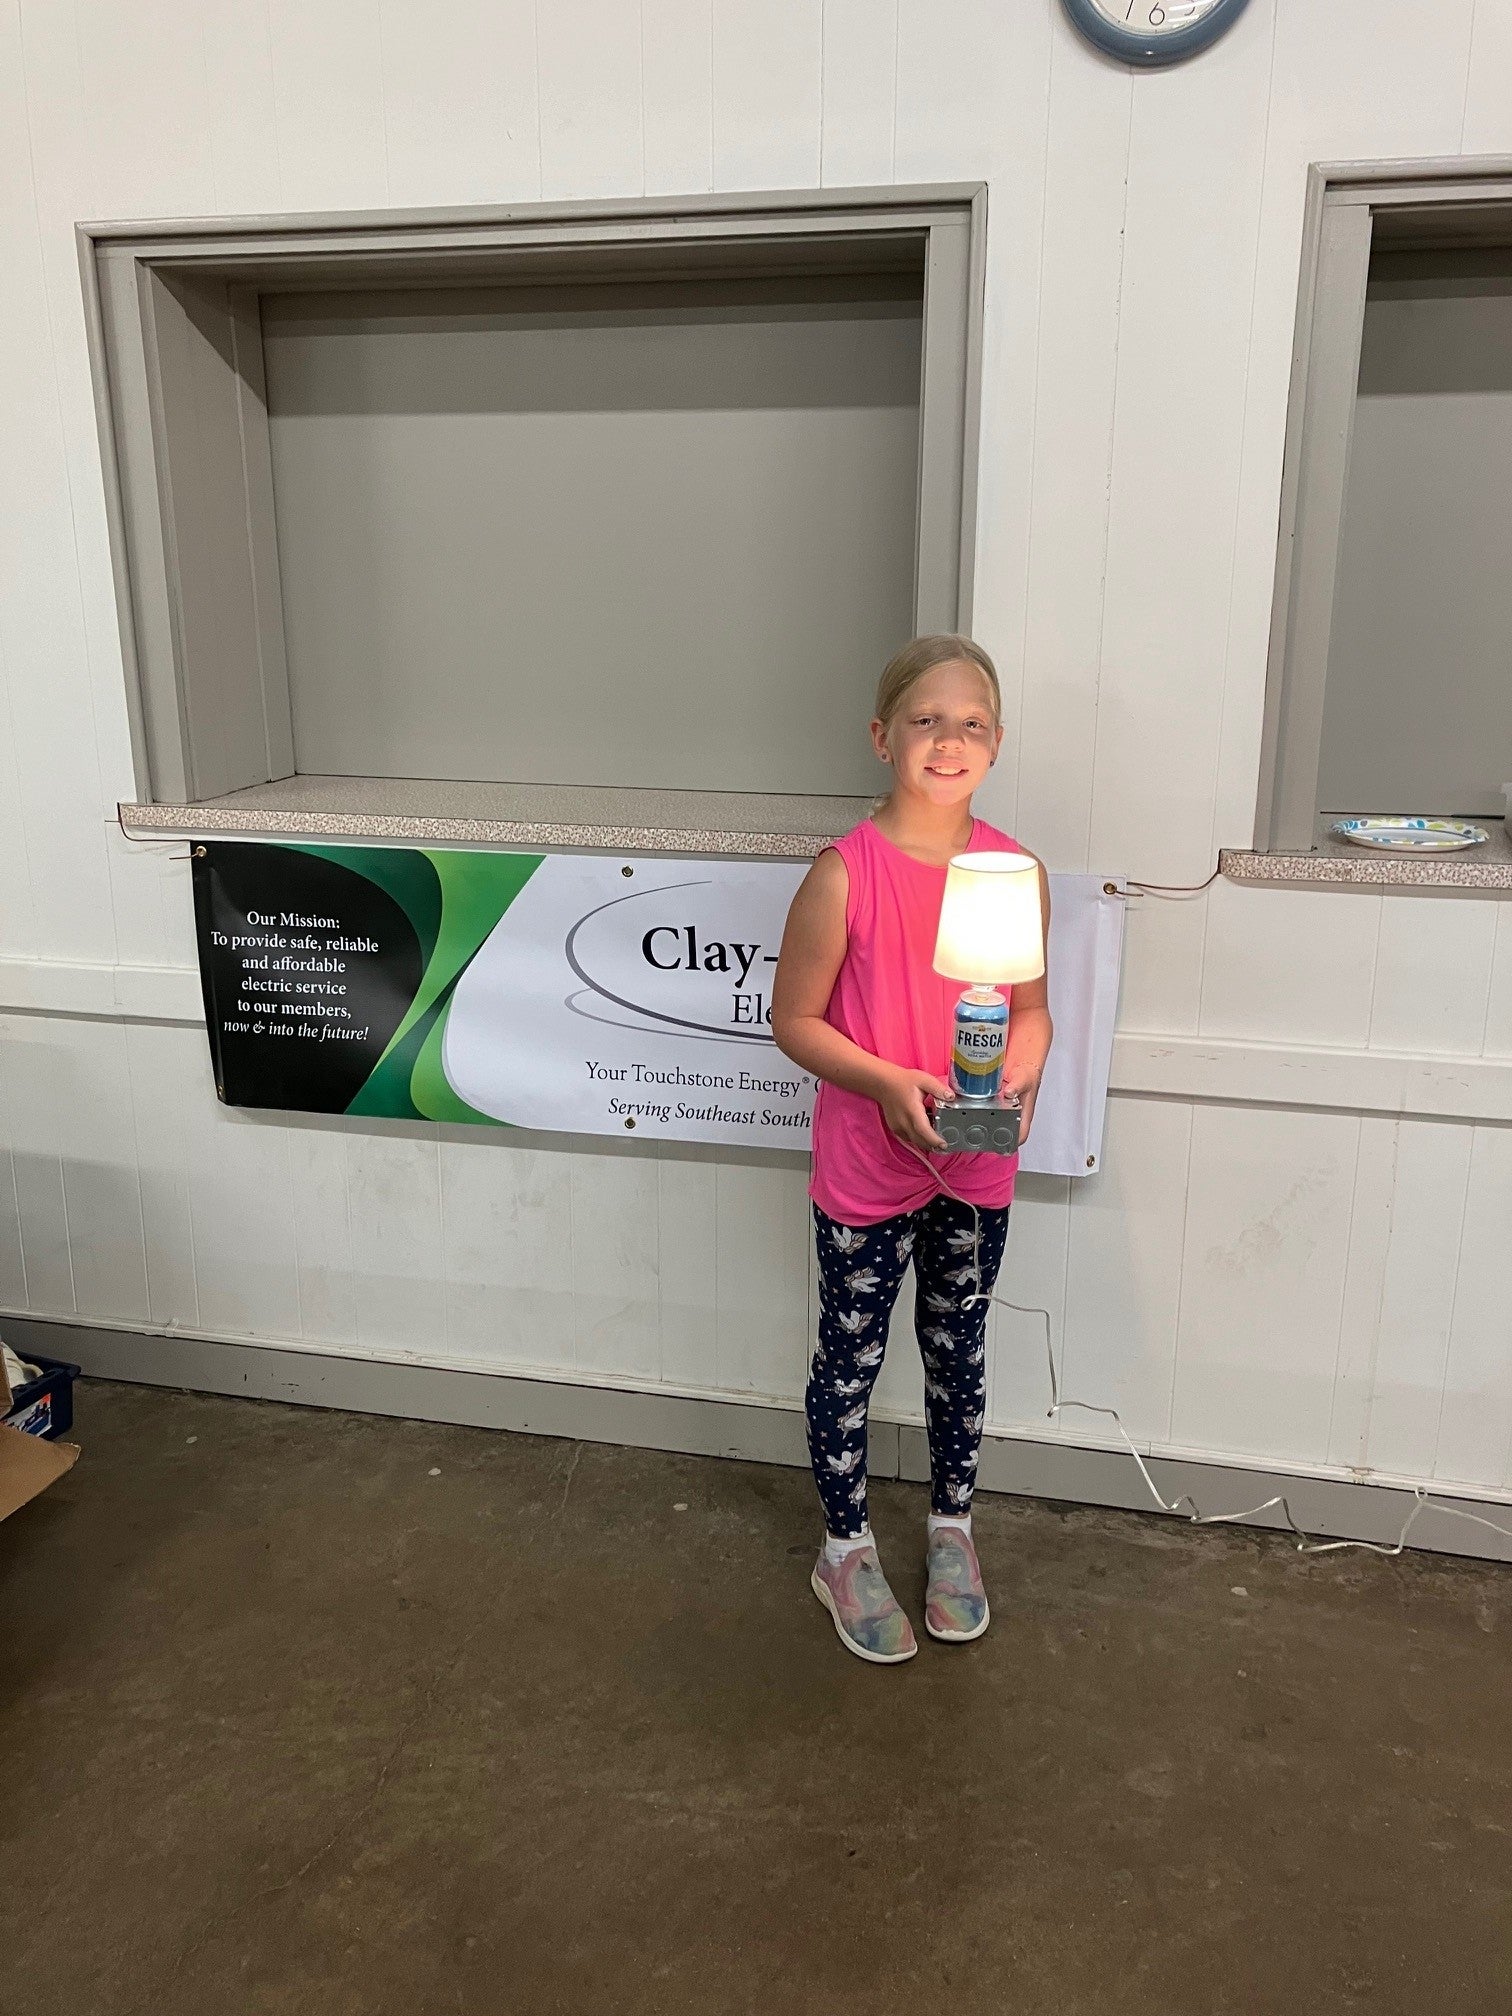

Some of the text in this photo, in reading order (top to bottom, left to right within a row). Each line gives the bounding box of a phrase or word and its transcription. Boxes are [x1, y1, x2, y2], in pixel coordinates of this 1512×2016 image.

[1149, 2, 1165, 26] 6
[246, 911, 340, 929] Our Mission:
[211, 931, 379, 952] To provide safe, reliable
[242, 955, 346, 973] and affordable
[641, 926, 778, 989] Clay-
[241, 976, 347, 995] electric service
[237, 999, 352, 1019] to our members,
[224, 1020, 369, 1043] now & into the future!
[958, 1029, 1003, 1048] FRESCA
[585, 1061, 627, 1081] Your
[632, 1063, 734, 1089] Touchstone
[608, 1098, 811, 1128] Serving Southeast South
